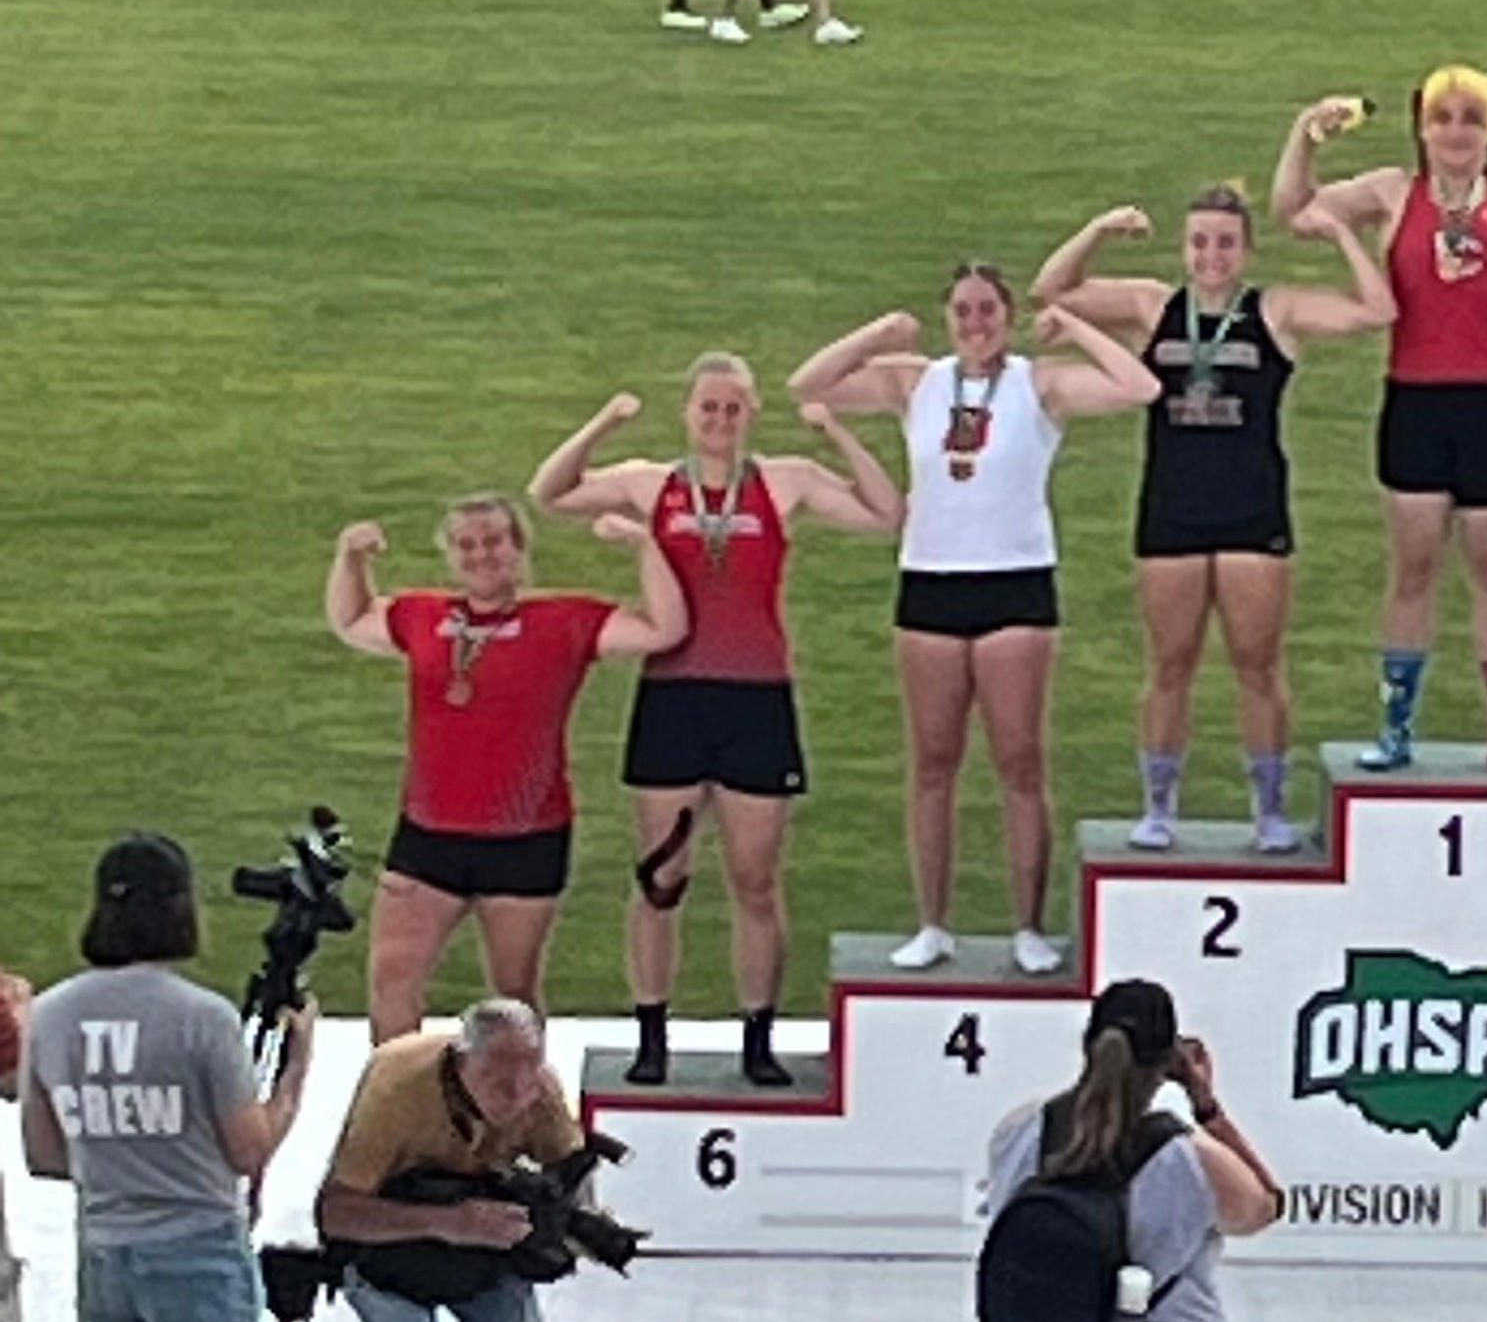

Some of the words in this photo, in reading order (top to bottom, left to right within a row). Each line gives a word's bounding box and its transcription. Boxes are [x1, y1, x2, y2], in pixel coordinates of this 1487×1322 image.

[1438, 815, 1462, 877] 1
[1202, 896, 1242, 958] 2
[80, 1020, 139, 1074] TV
[944, 1013, 986, 1075] 4
[50, 1084, 183, 1138] CREW
[697, 1128, 737, 1189] 6
